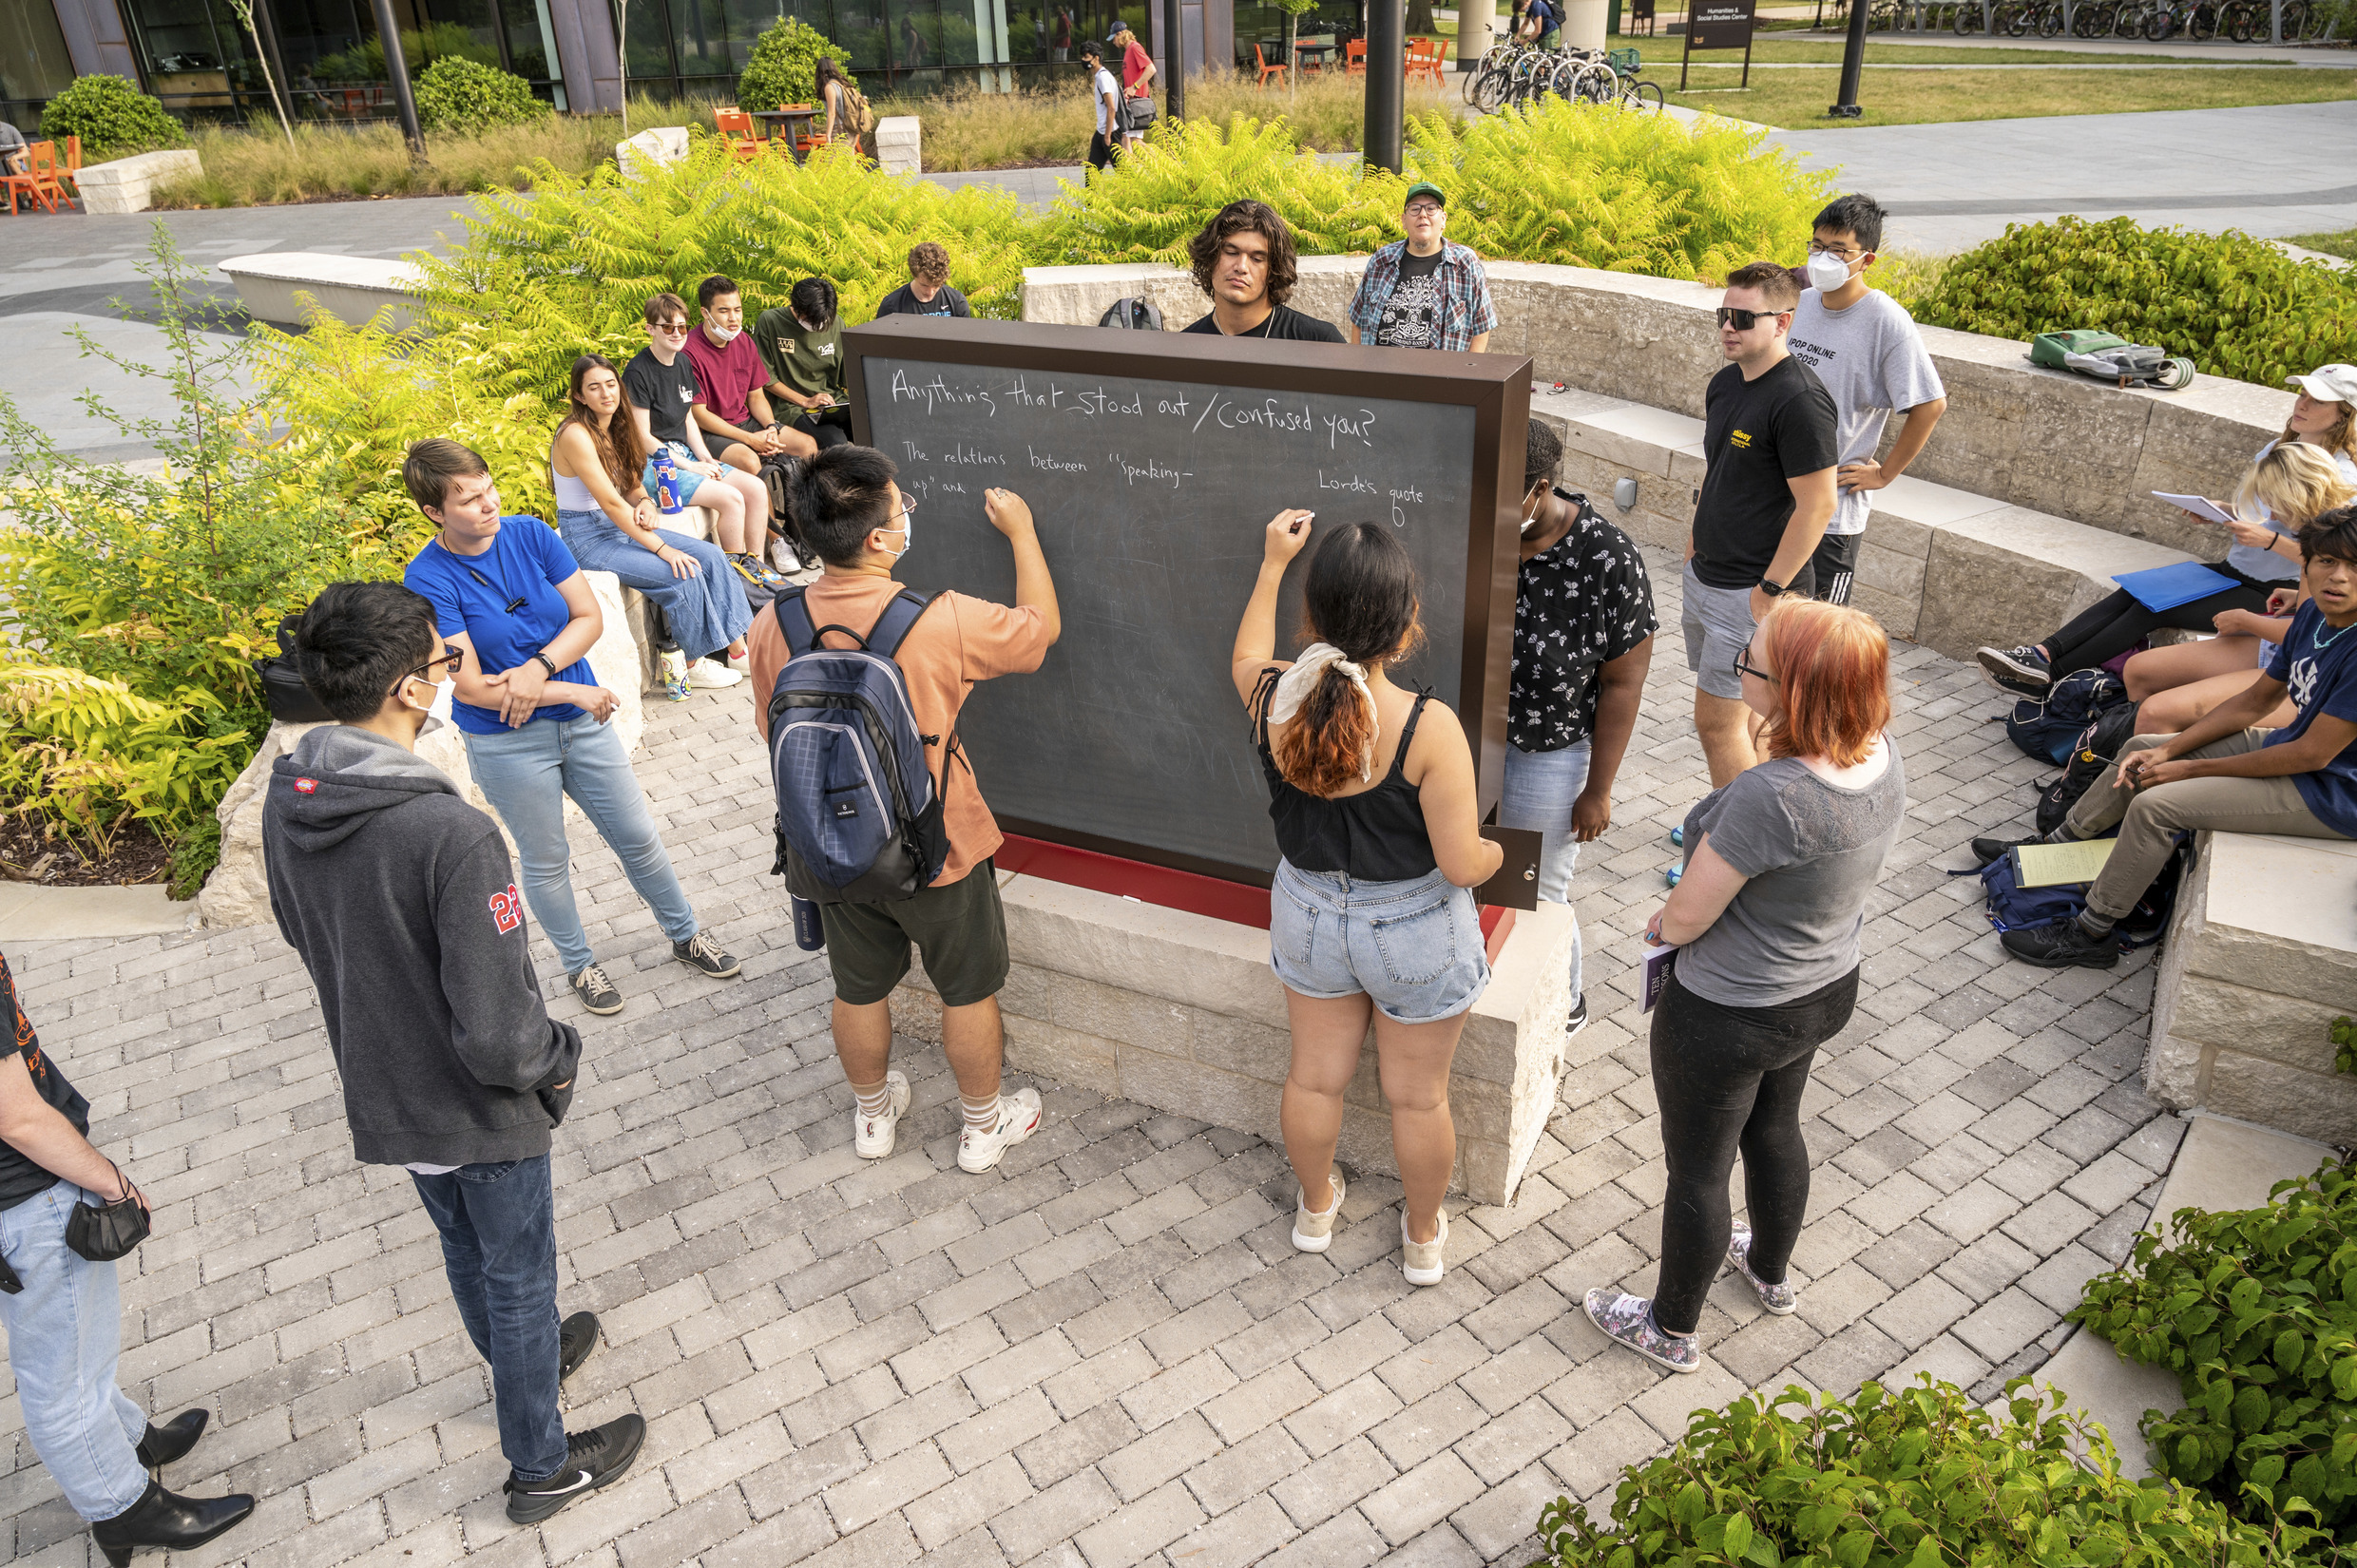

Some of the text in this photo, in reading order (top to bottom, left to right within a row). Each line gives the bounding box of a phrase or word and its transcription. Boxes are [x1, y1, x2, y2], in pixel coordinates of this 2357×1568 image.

[1788, 337, 1836, 359] IPOP ONLINE
[1796, 353, 1819, 367] 2020
[1005, 373, 1064, 409] that
[1158, 391, 1190, 417] out
[1323, 408, 1376, 450] you?
[902, 440, 930, 463] The
[944, 442, 1006, 466] relations
[1027, 444, 1088, 473] between
[942, 482, 967, 494] and
[1318, 468, 1425, 527] Lorde's quote
[1651, 976, 1660, 996] TEN
[1660, 963, 1670, 989] SONS
